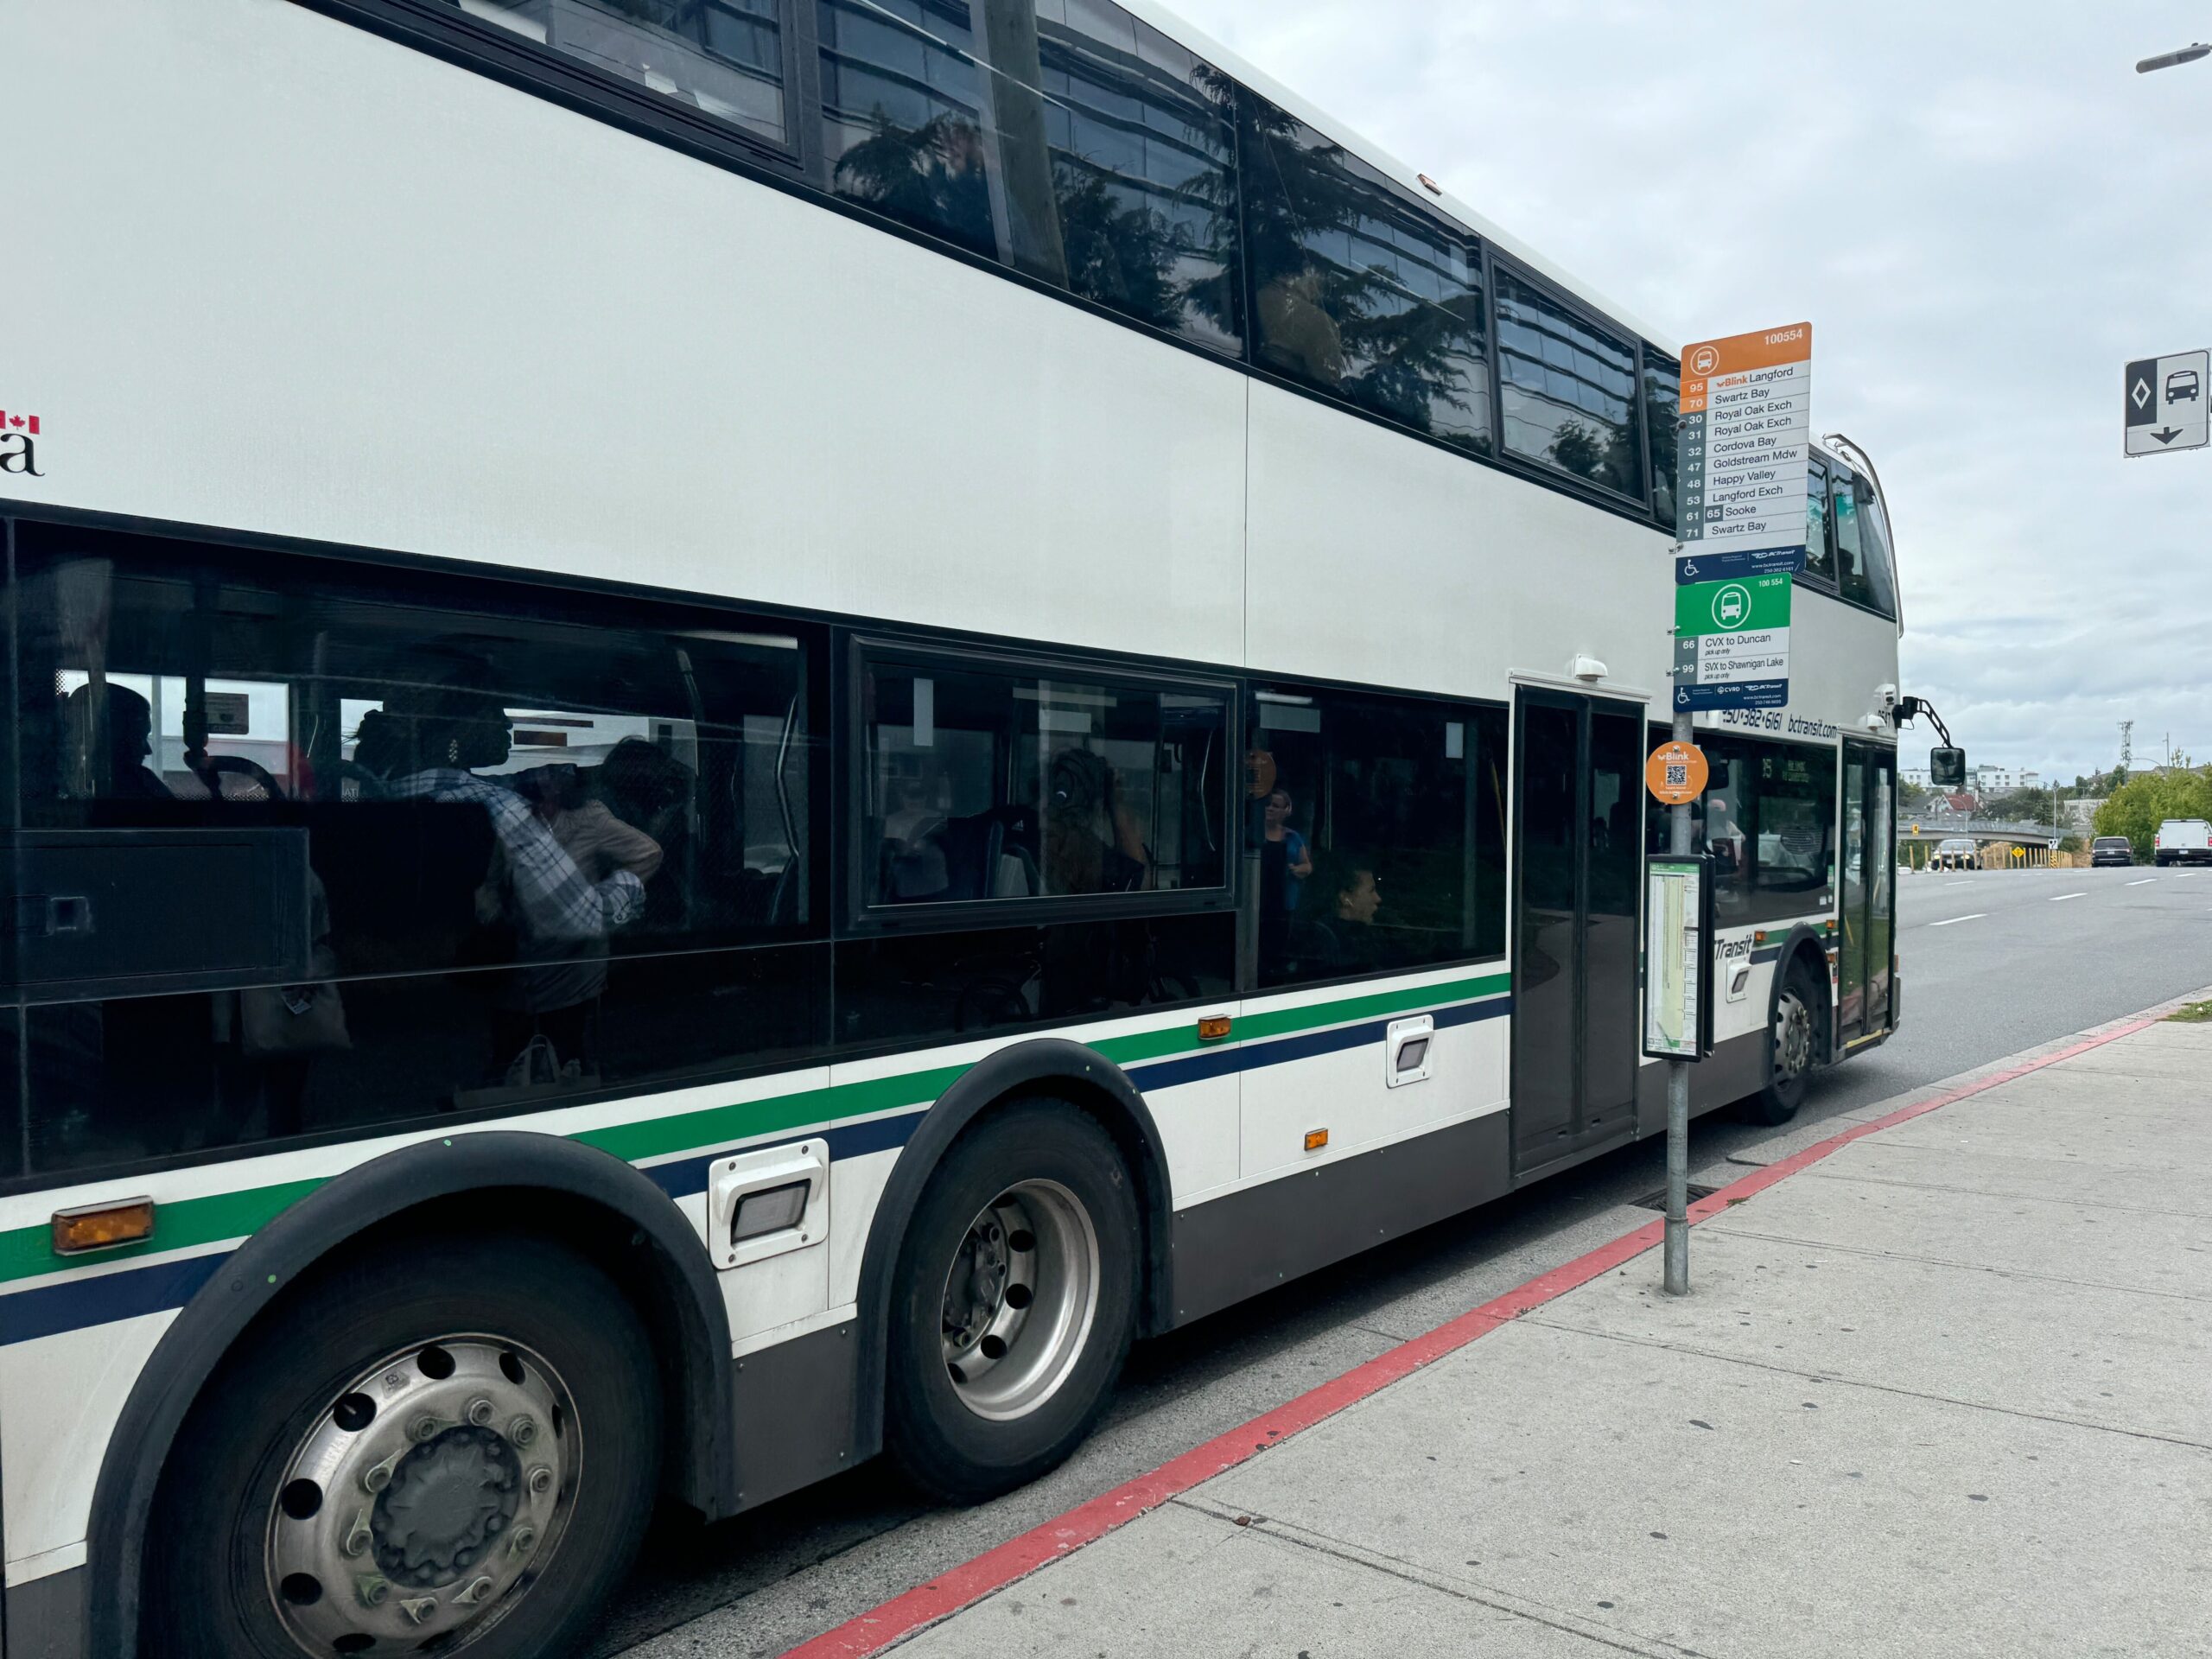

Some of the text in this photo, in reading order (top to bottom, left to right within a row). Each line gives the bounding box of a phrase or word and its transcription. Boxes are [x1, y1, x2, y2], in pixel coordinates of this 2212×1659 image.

[1764, 328, 1803, 345] 100554
[1725, 367, 1794, 387] Blink Langford
[1690, 383, 1704, 392] 95
[1715, 389, 1770, 404] Swartz Bay
[1690, 399, 1703, 409] 70
[1715, 401, 1792, 421] Royal Oak Exch
[1688, 415, 1702, 424] 30
[1714, 416, 1792, 437] Royal Oak Exch
[1688, 430, 1701, 440] 31
[1688, 448, 1702, 456] 32
[1714, 437, 1777, 453] Cordova Bay
[1713, 449, 1797, 468] Goldstream Mdw
[1688, 463, 1700, 472] 47
[1687, 480, 1700, 489] 48
[1713, 470, 1777, 486] Happy Valley
[1687, 496, 1700, 505] 53
[1713, 486, 1783, 503] Langford Exch
[1687, 505, 1756, 521] 61 65 Sooke
[1687, 529, 1699, 537] 71
[1712, 522, 1766, 535] Swartz Bay
[1682, 640, 1695, 650] 66
[1705, 638, 1724, 648] CVX
[1737, 634, 1771, 645] Duncan
[1682, 664, 1694, 673] 99
[1704, 657, 1783, 671] SVX to Shawnigan Lake
[1788, 715, 1837, 739] bctransit.com
[1666, 752, 1688, 760] Blink
[1714, 934, 1752, 960] Transit
